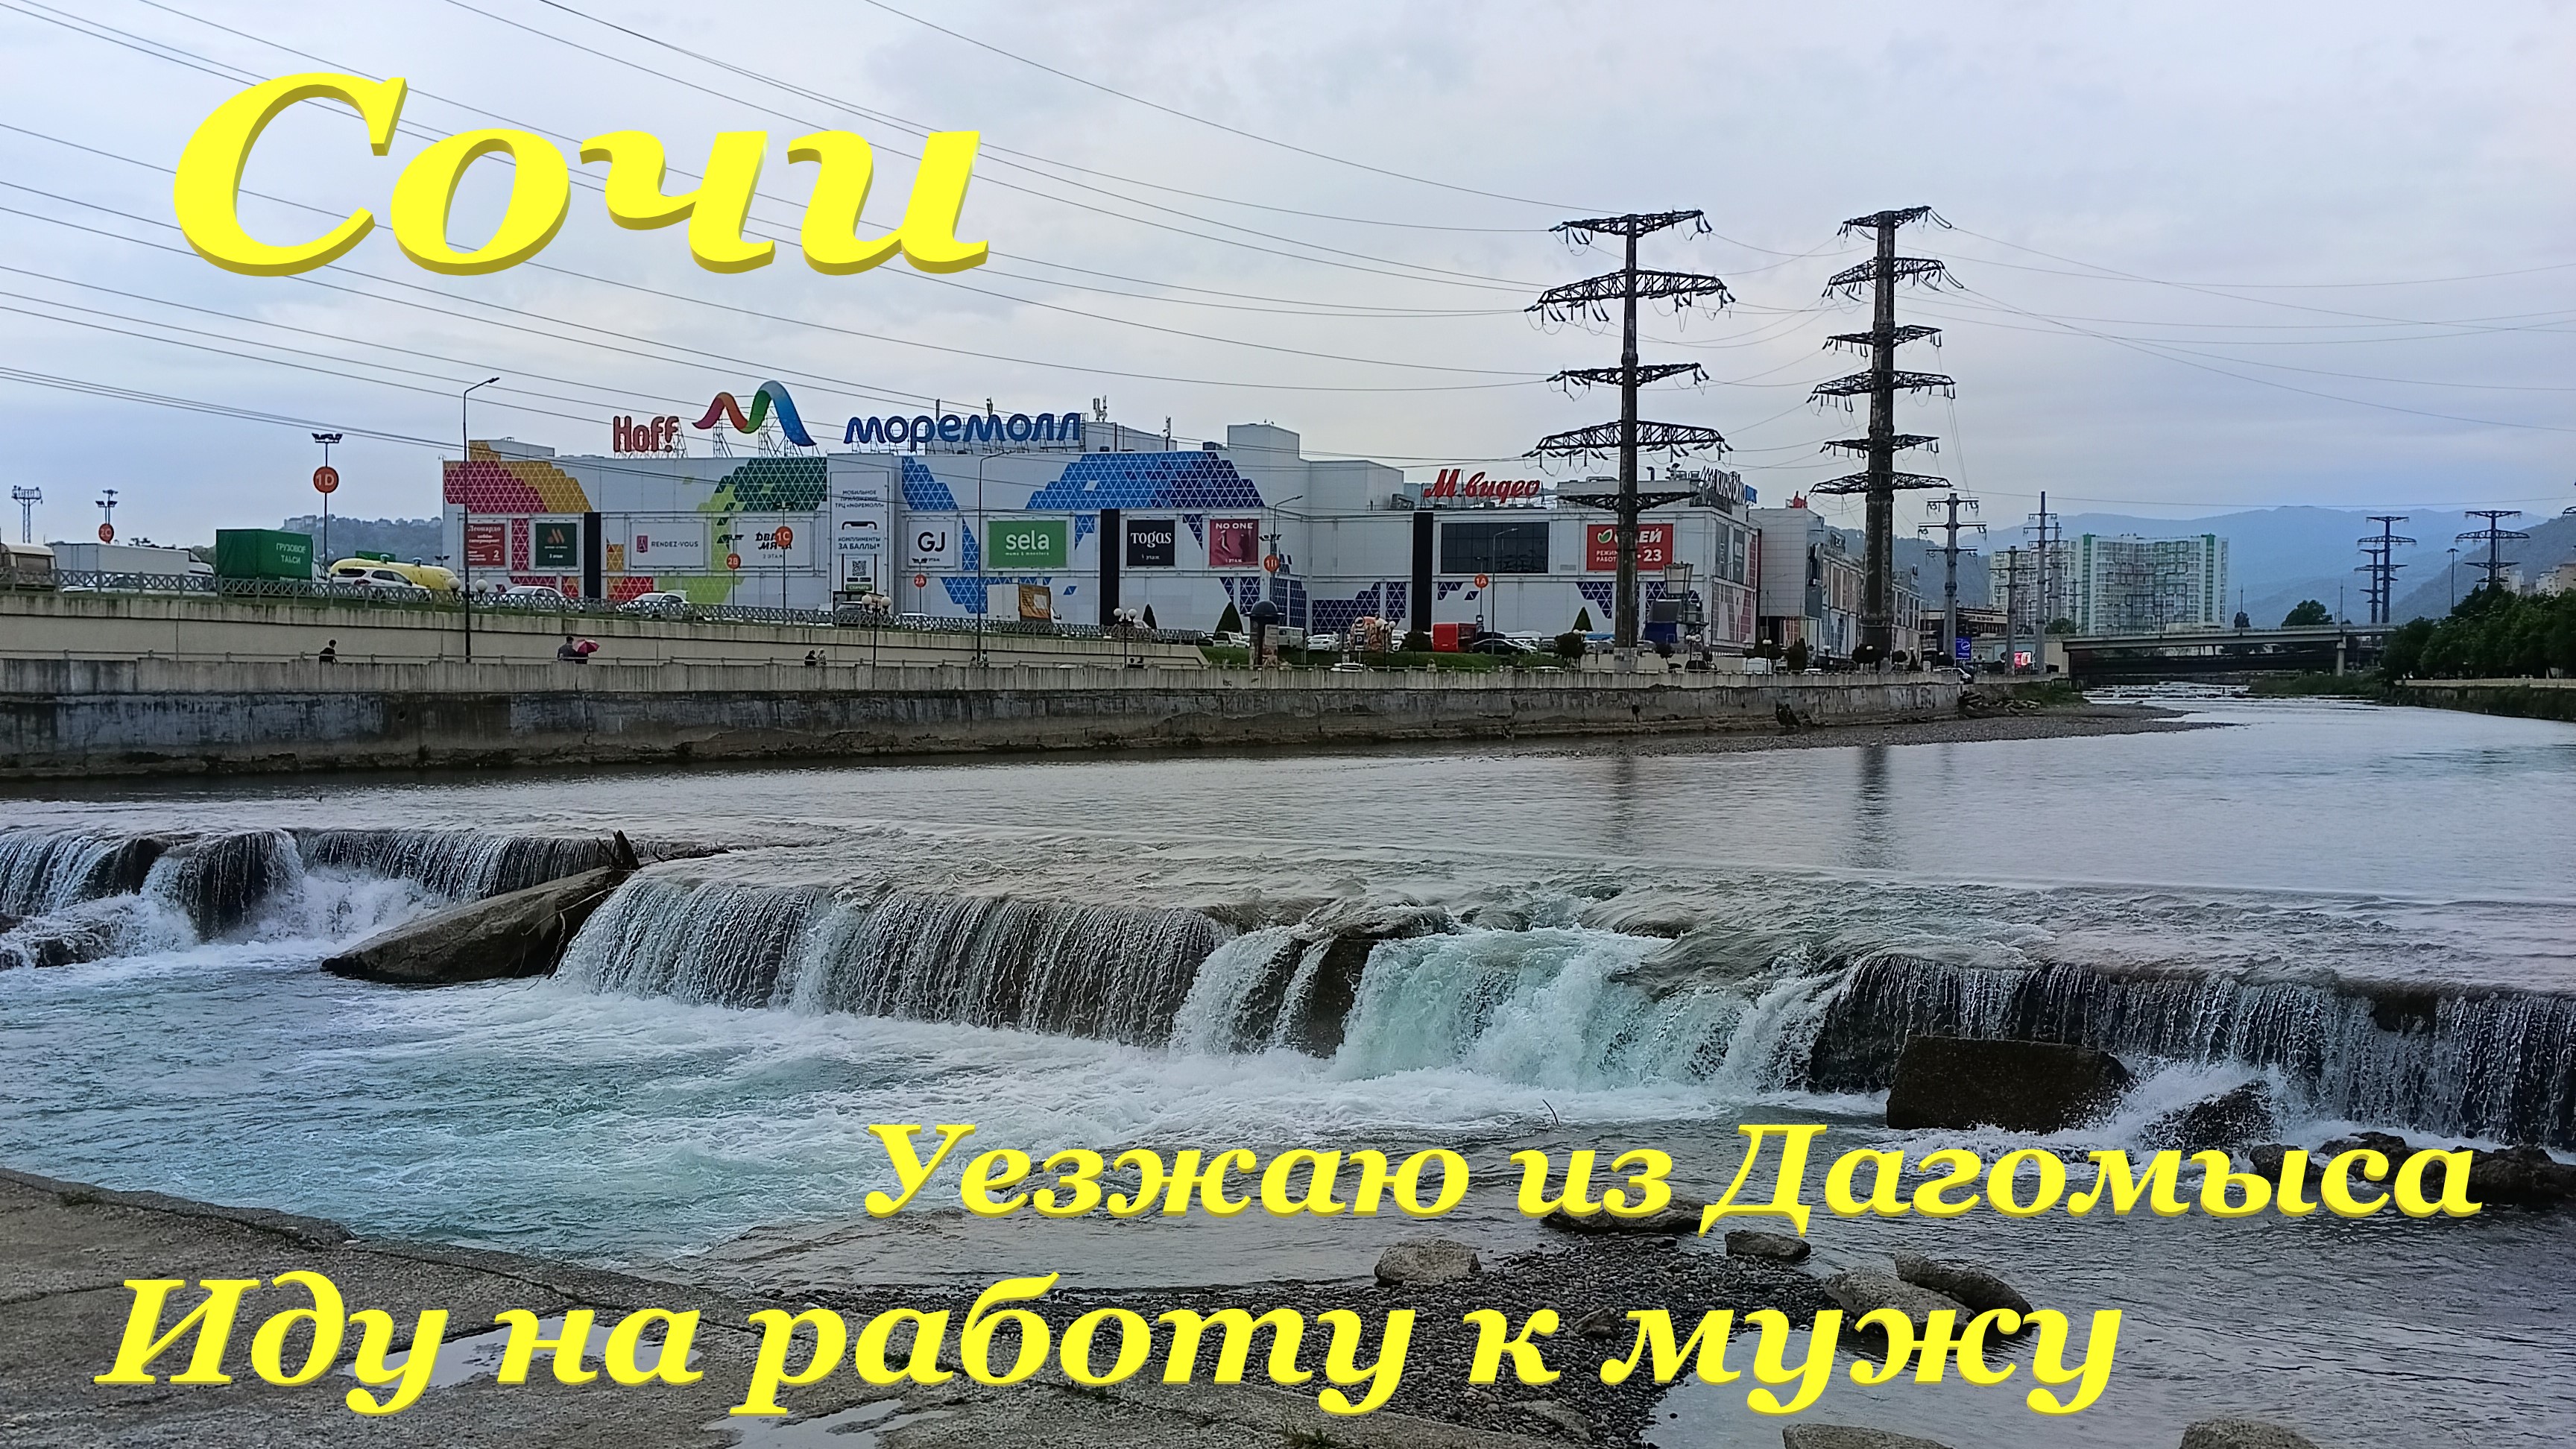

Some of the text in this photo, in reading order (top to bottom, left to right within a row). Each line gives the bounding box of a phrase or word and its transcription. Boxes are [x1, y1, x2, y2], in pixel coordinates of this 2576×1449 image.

[613, 416, 679, 452] Hoff
[316, 474, 335, 486] 1D
[777, 531, 790, 540] 1C
[918, 531, 945, 552] GJ
[1006, 530, 1049, 549] sela
[277, 543, 306, 553] ГРУЗОВОЕ
[493, 549, 499, 558] 2
[1644, 549, 1662, 561] 23
